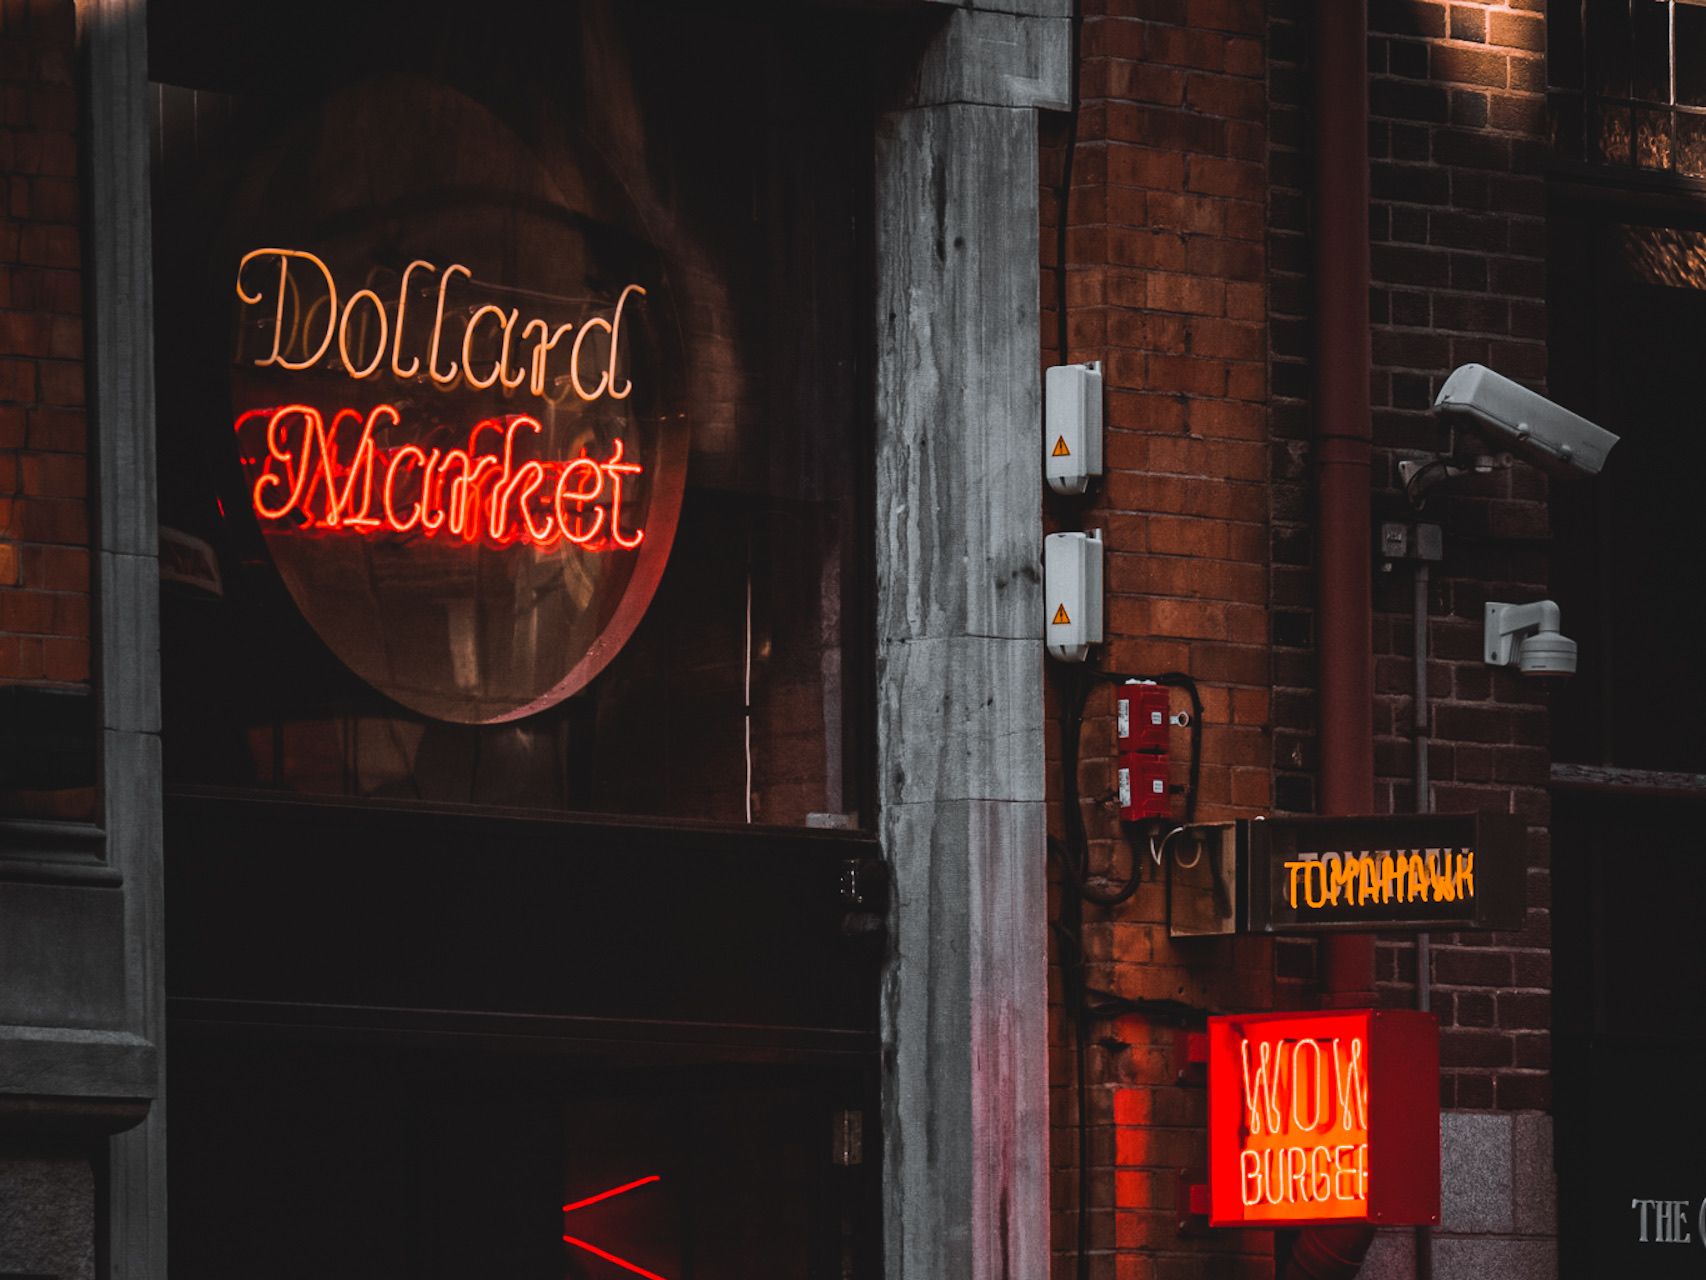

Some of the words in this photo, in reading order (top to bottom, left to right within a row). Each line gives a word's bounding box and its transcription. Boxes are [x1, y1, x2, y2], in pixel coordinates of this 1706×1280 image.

[236, 247, 647, 400] Dollard
[253, 404, 644, 549] Market
[1283, 849, 1475, 909] TOMAHAWK
[1241, 1037, 1367, 1135] WOW
[1631, 1198, 1691, 1244] THE
